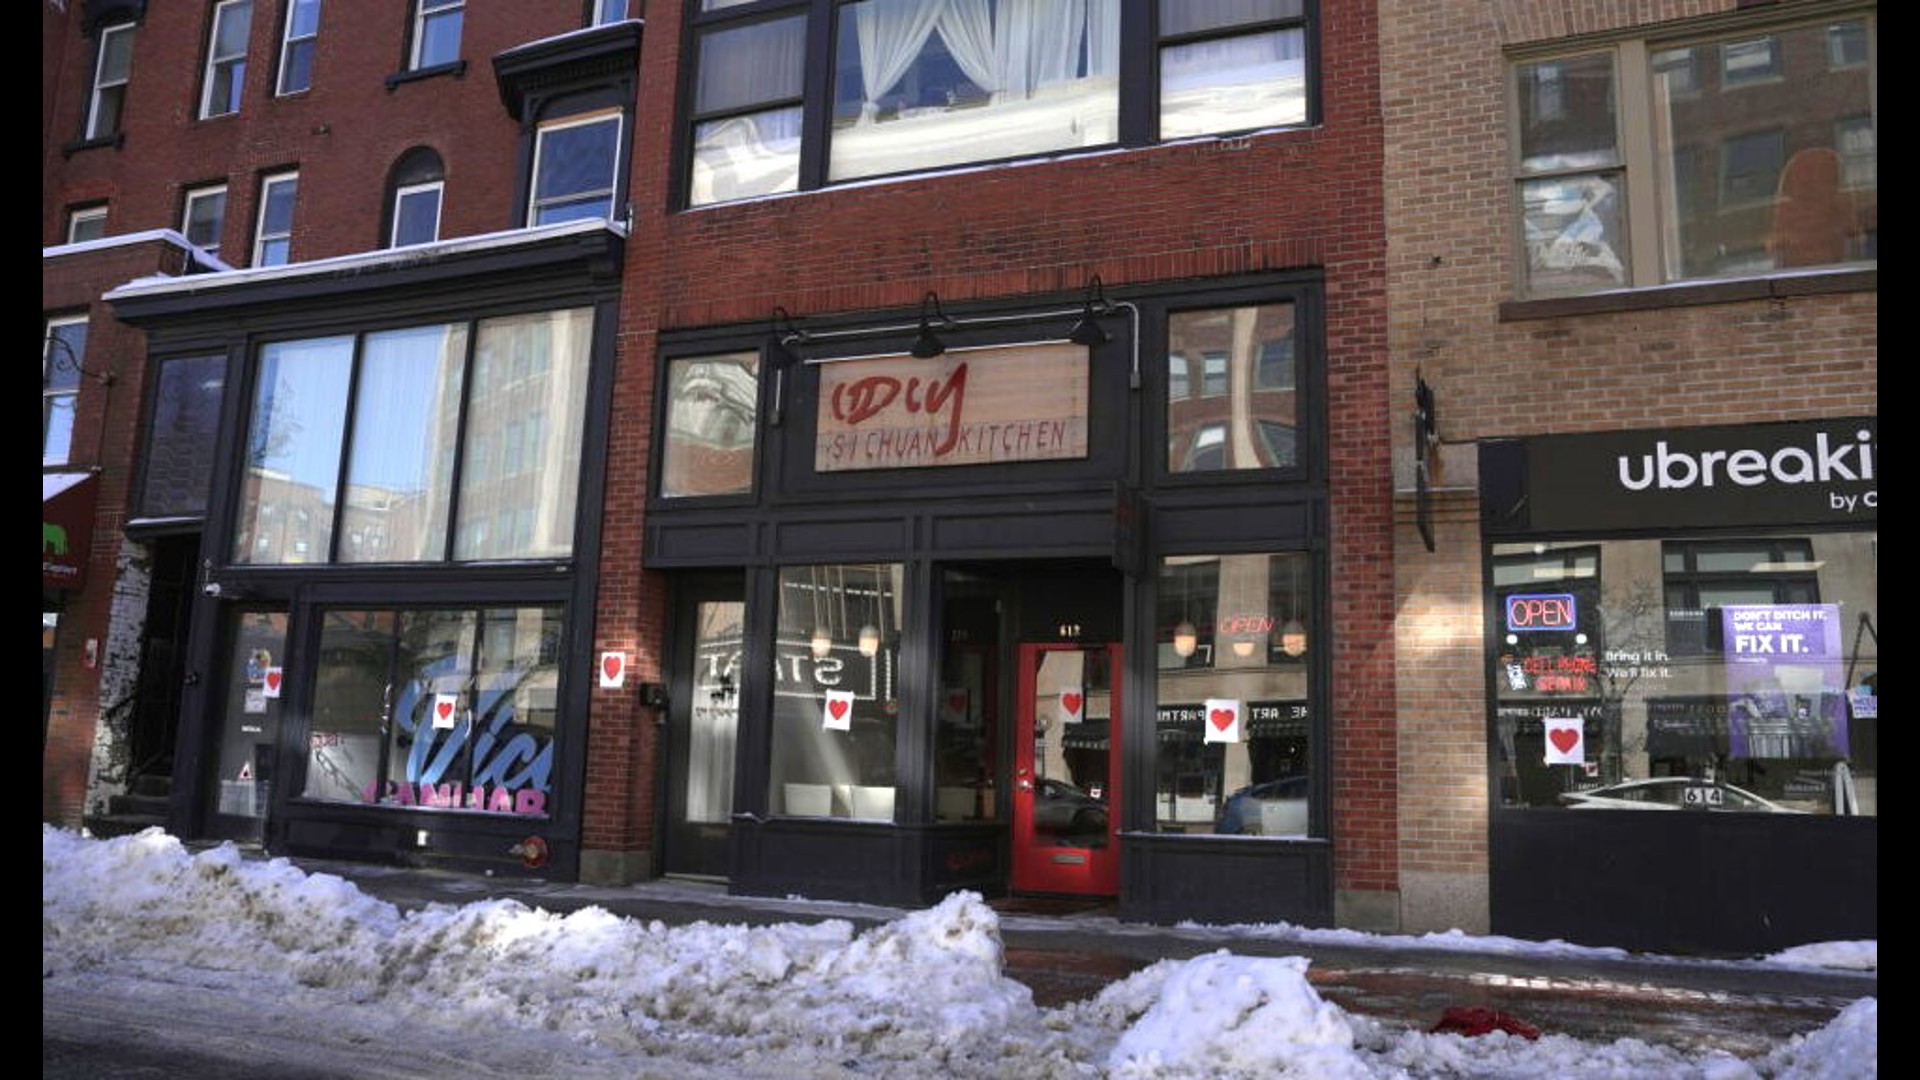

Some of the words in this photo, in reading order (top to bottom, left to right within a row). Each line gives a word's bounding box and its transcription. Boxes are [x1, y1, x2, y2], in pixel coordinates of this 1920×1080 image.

[832, 425, 940, 459] SICHUAN
[957, 420, 1067, 452] KITCHEN
[1618, 429, 1877, 490] ubreaki
[1829, 492, 1858, 513] by
[1511, 599, 1573, 626] OPEN
[1773, 610, 1811, 620] DITCH
[1059, 624, 1081, 637] 612
[1756, 622, 1783, 631] CAN
[1735, 634, 1775, 654] FIX
[1781, 633, 1809, 654] IT.
[1605, 650, 1640, 665] Bring
[1643, 650, 1652, 661] it
[1640, 666, 1657, 678] fix
